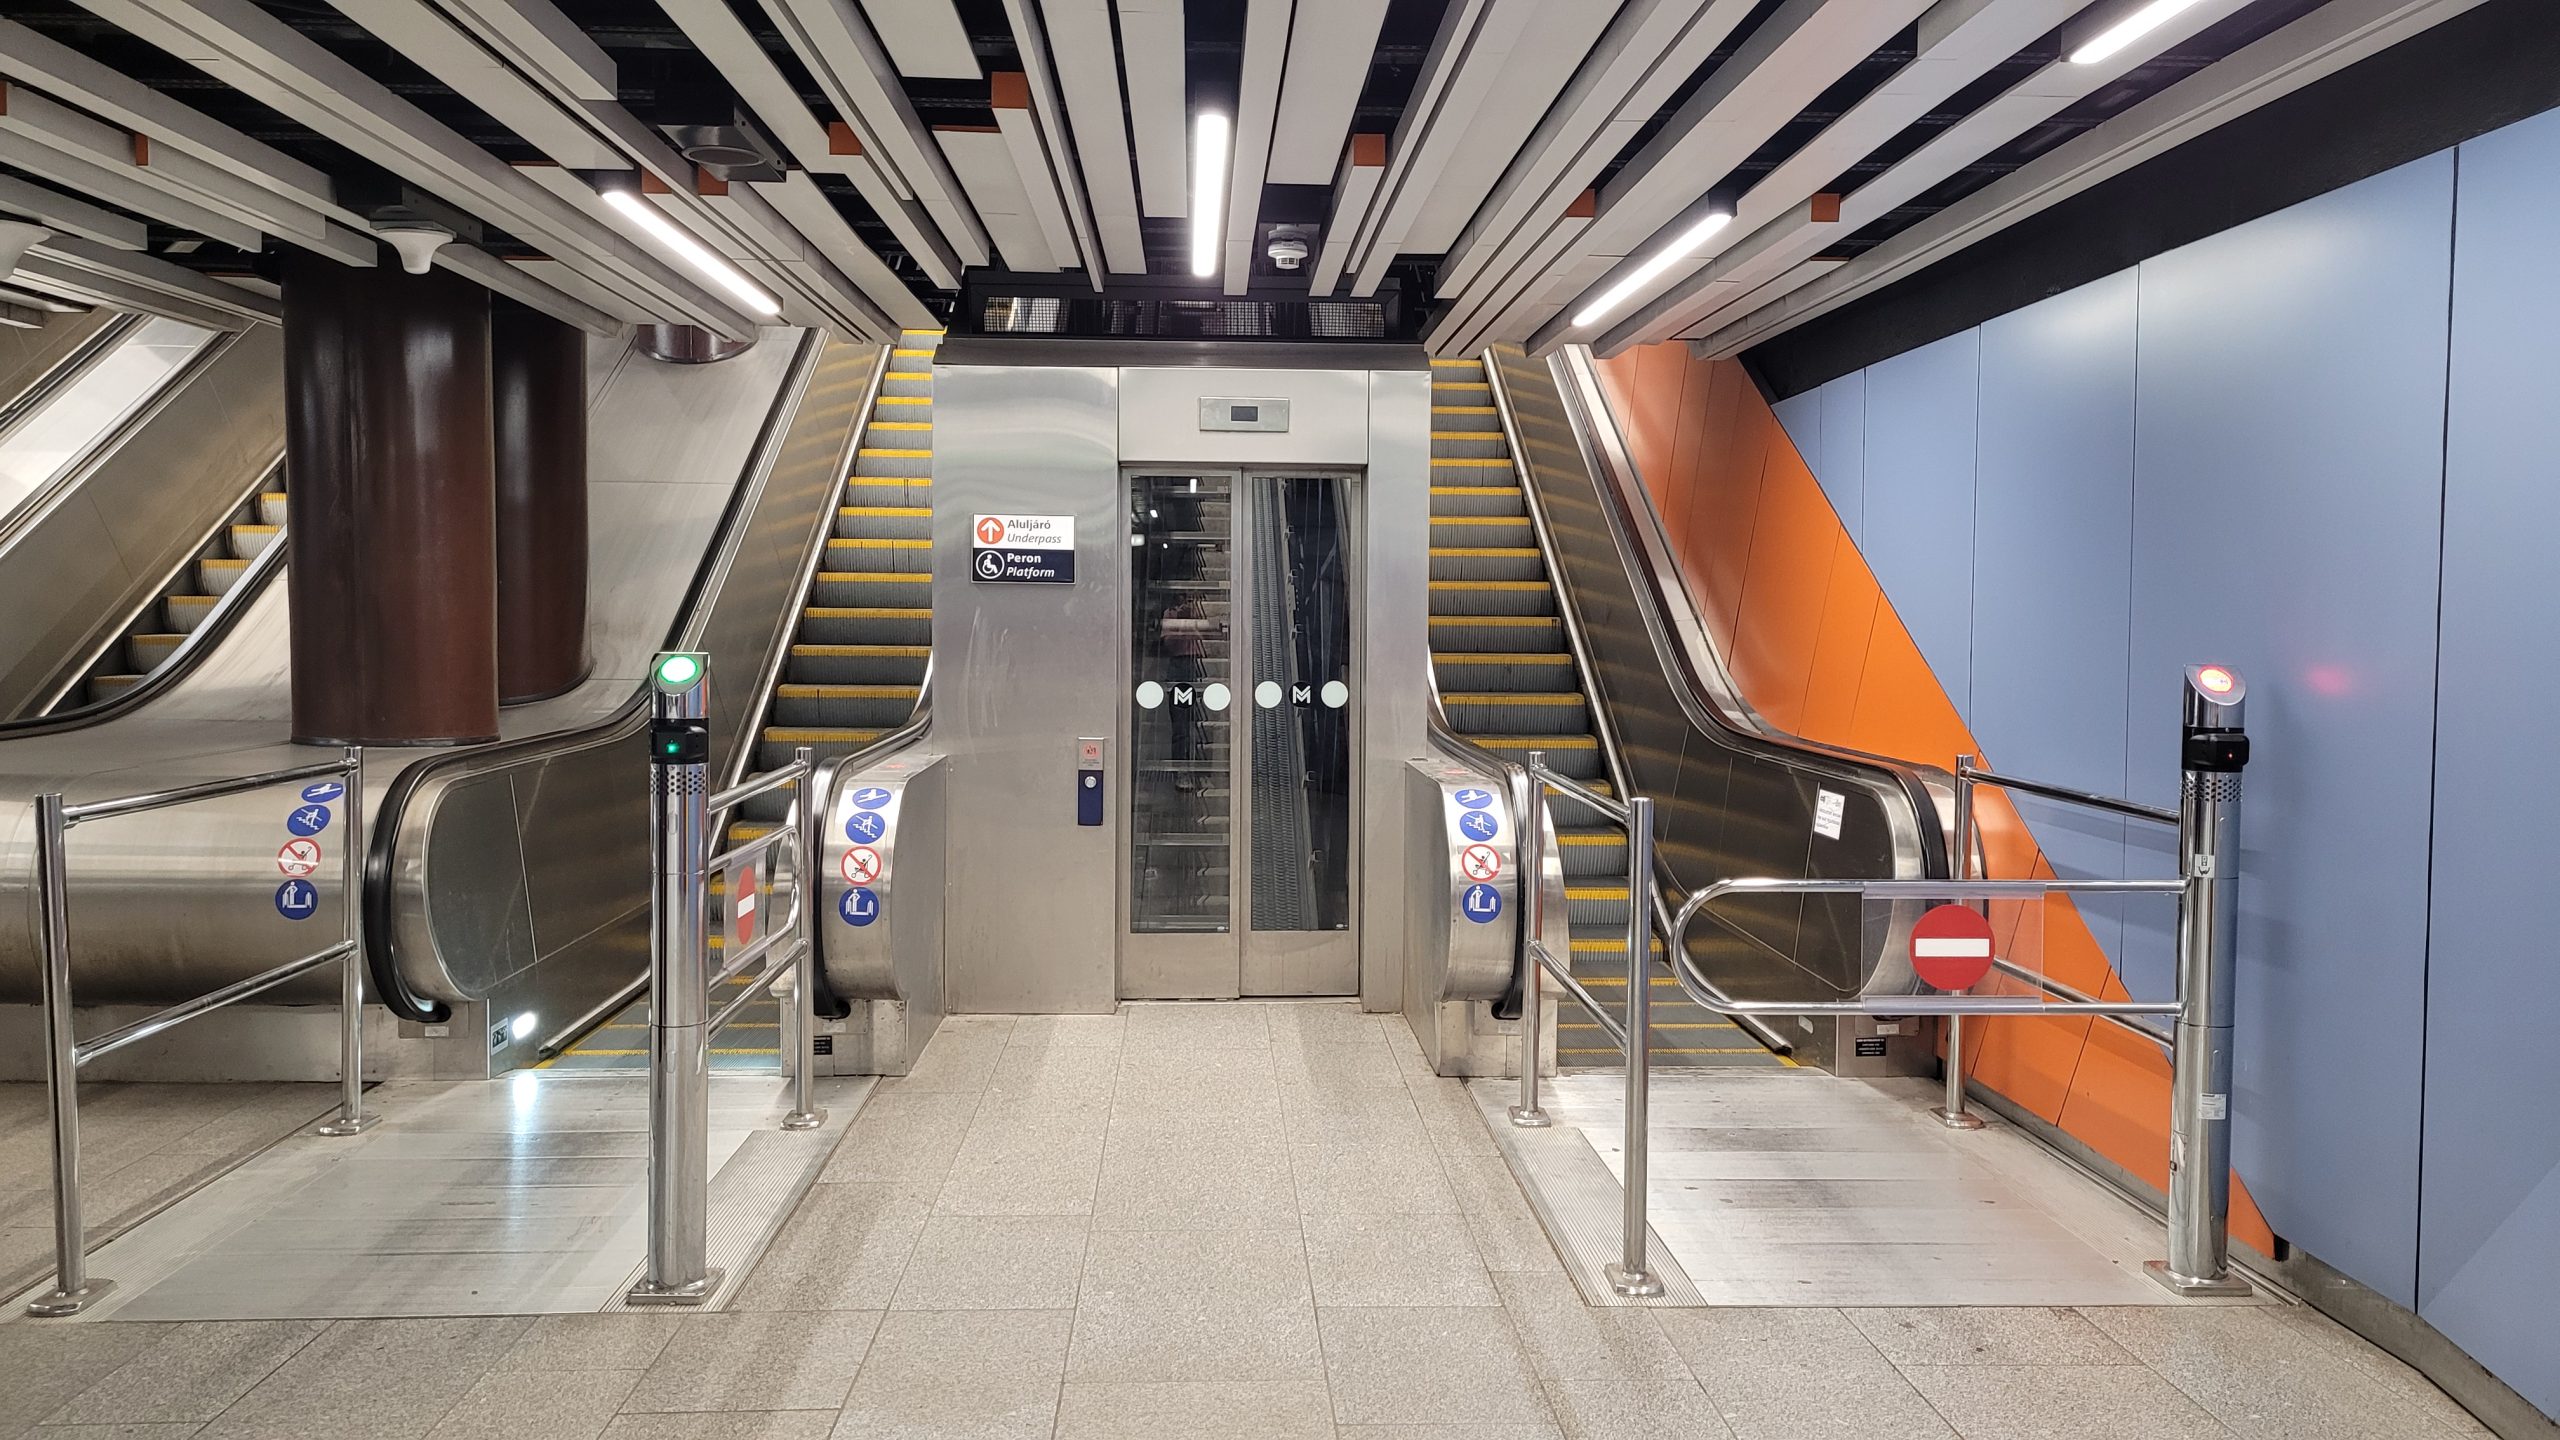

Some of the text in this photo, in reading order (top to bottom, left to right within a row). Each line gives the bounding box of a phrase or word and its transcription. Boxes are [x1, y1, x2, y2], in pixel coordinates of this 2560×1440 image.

[1007, 519, 1051, 531] Aluljáró
[1007, 533, 1062, 545] Underpass
[1006, 552, 1042, 564] Peron
[1006, 566, 1055, 580] Platform
